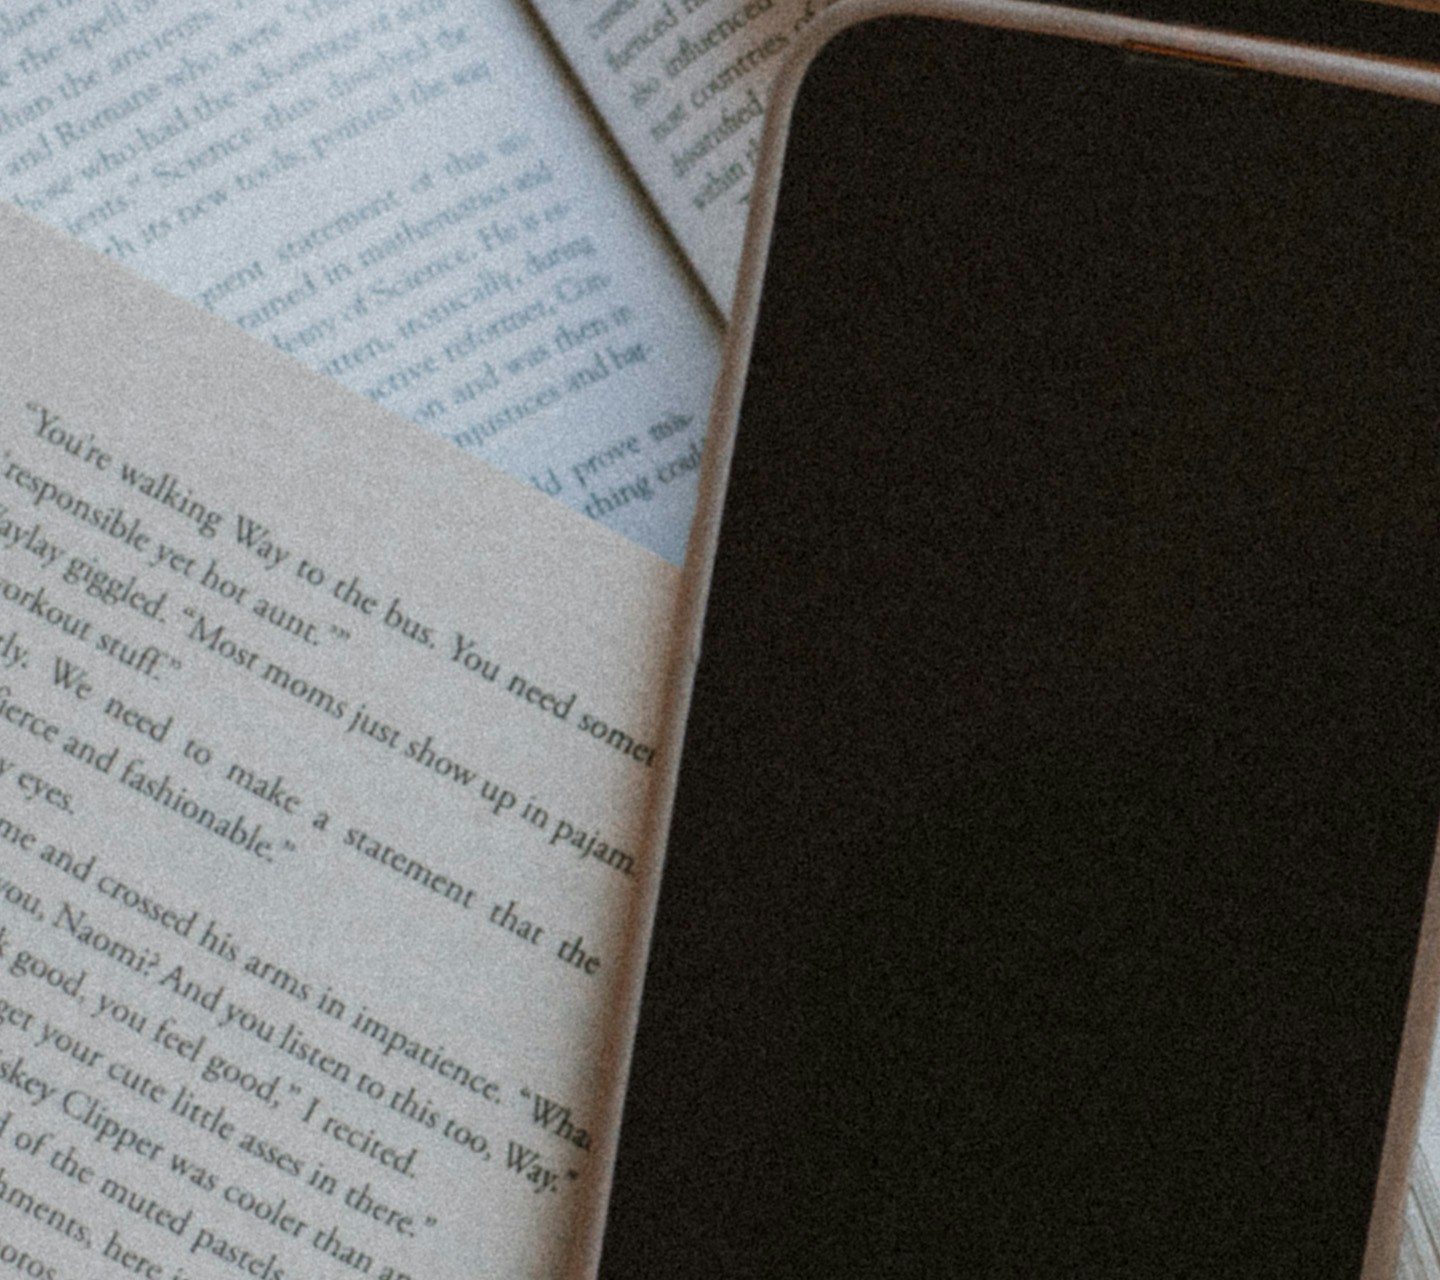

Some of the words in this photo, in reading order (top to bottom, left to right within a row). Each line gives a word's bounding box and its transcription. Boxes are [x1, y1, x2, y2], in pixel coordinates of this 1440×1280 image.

[24, 400, 113, 471] “You’re
[118, 461, 224, 539] walking
[233, 512, 291, 571] Way
[293, 556, 328, 587] to
[329, 575, 379, 617] the
[381, 596, 436, 650] bus.
[449, 630, 501, 684] You
[504, 672, 578, 723] need
[14, 770, 75, 816] eyes.
